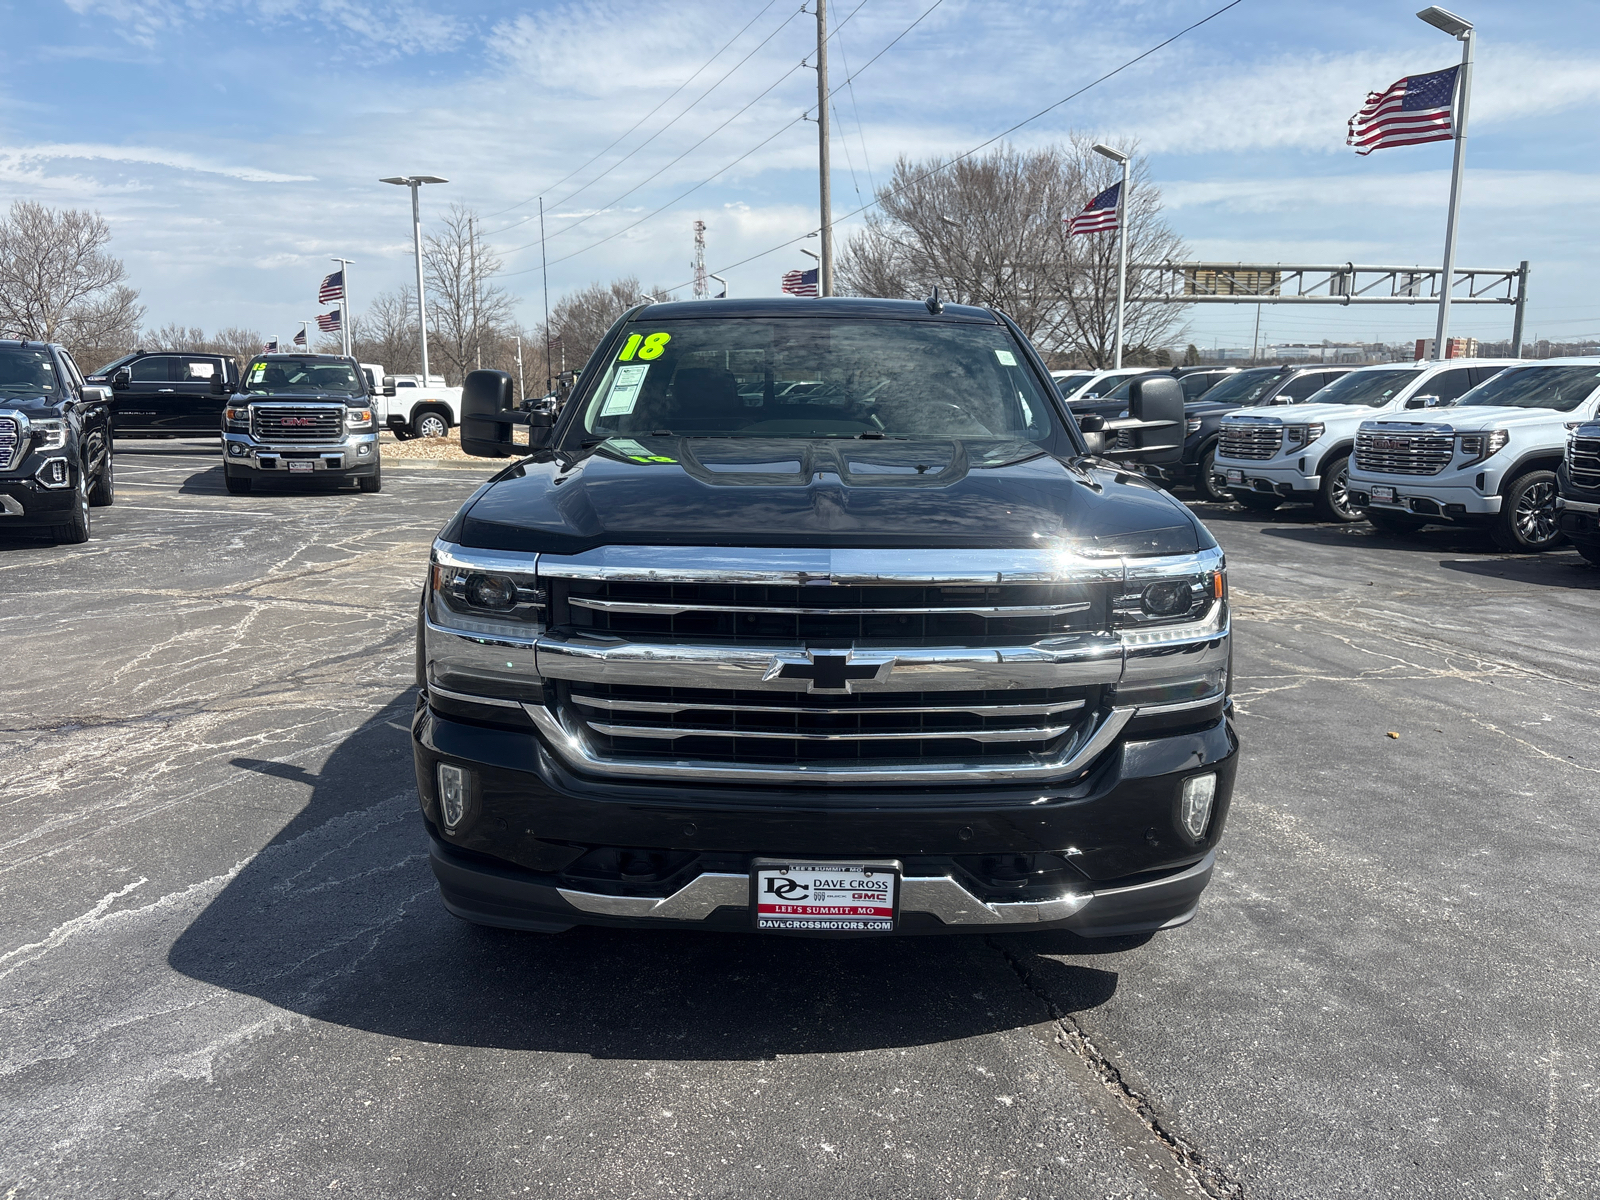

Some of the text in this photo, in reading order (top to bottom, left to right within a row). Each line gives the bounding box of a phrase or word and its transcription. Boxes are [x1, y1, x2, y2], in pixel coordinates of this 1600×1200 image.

[618, 332, 671, 361] 18
[253, 362, 268, 371] 15
[281, 417, 317, 426] GMC
[1373, 440, 1409, 450] GMC
[814, 879, 888, 890] DAVE CROSS
[852, 892, 887, 901] GMC
[806, 907, 854, 915] SUMMIT,
[759, 920, 891, 930] DAVECROSSMOTORS.COM
